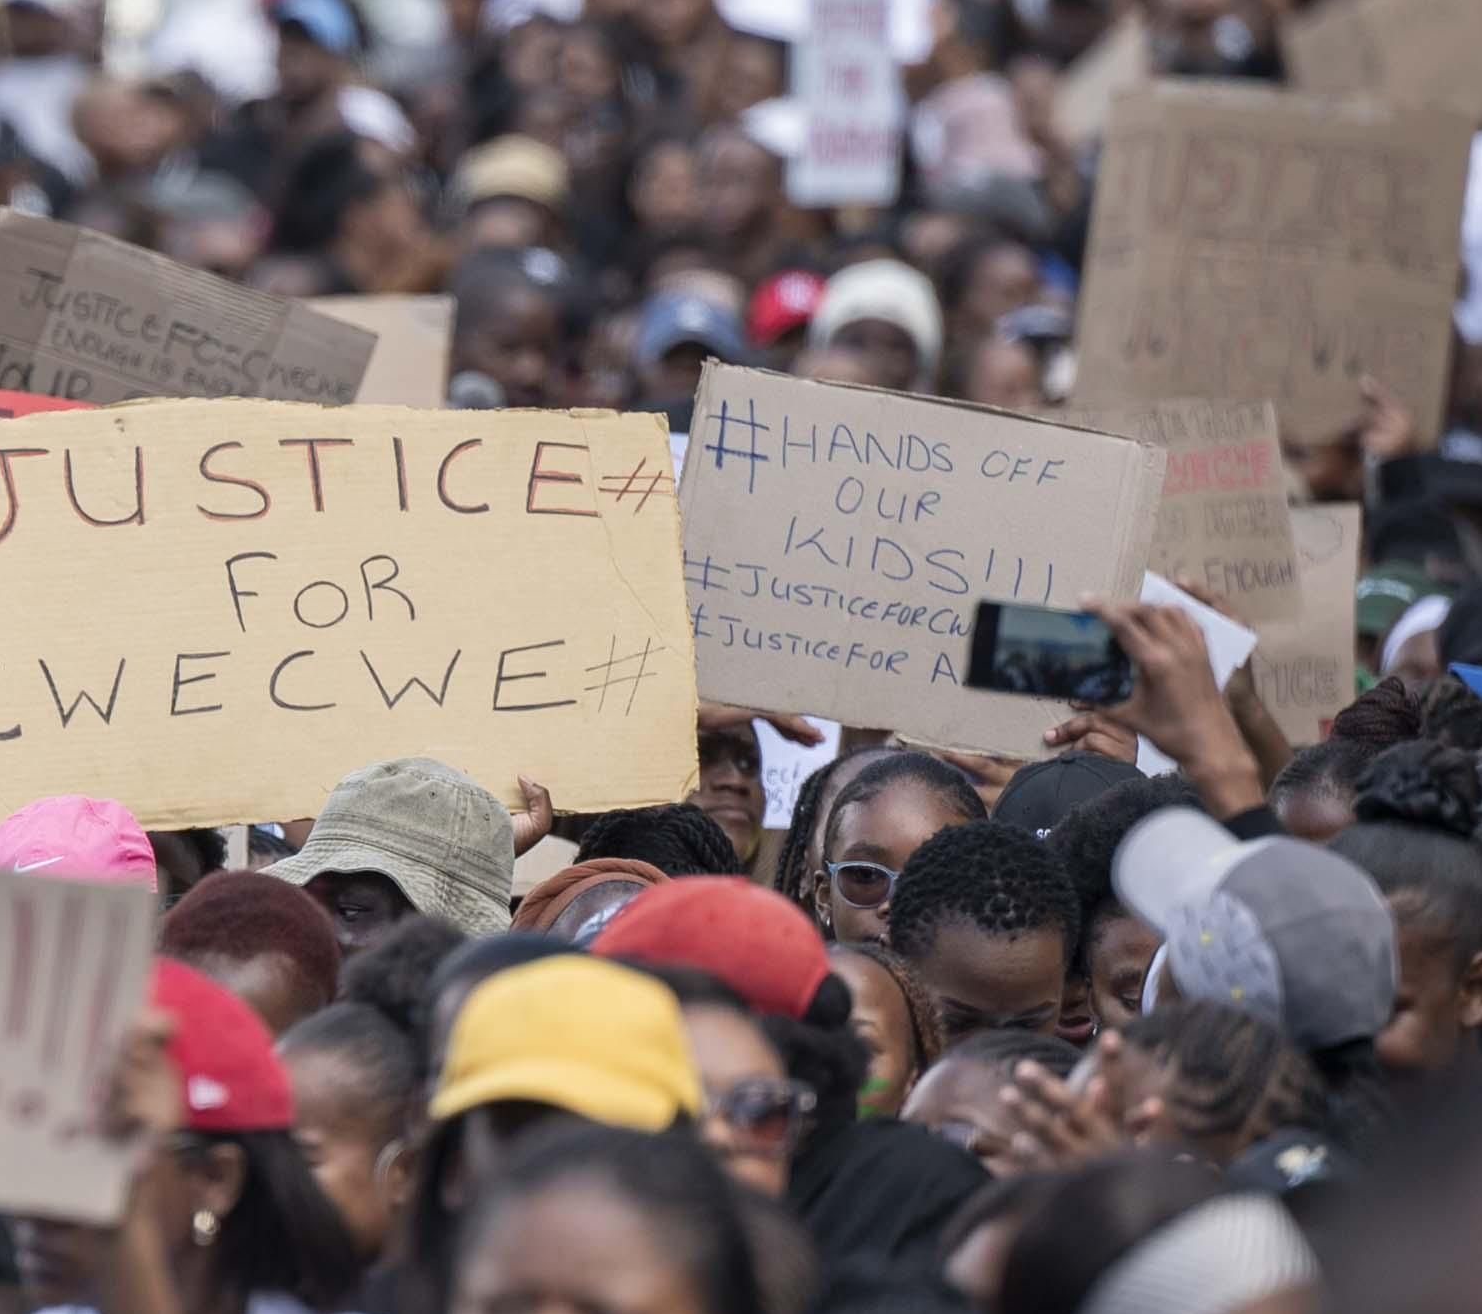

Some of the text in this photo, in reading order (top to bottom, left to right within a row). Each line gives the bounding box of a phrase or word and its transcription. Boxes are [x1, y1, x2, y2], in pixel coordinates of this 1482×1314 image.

[981, 450, 1065, 485] OFF
[835, 476, 941, 523] OUR
[225, 551, 416, 634] FOR
